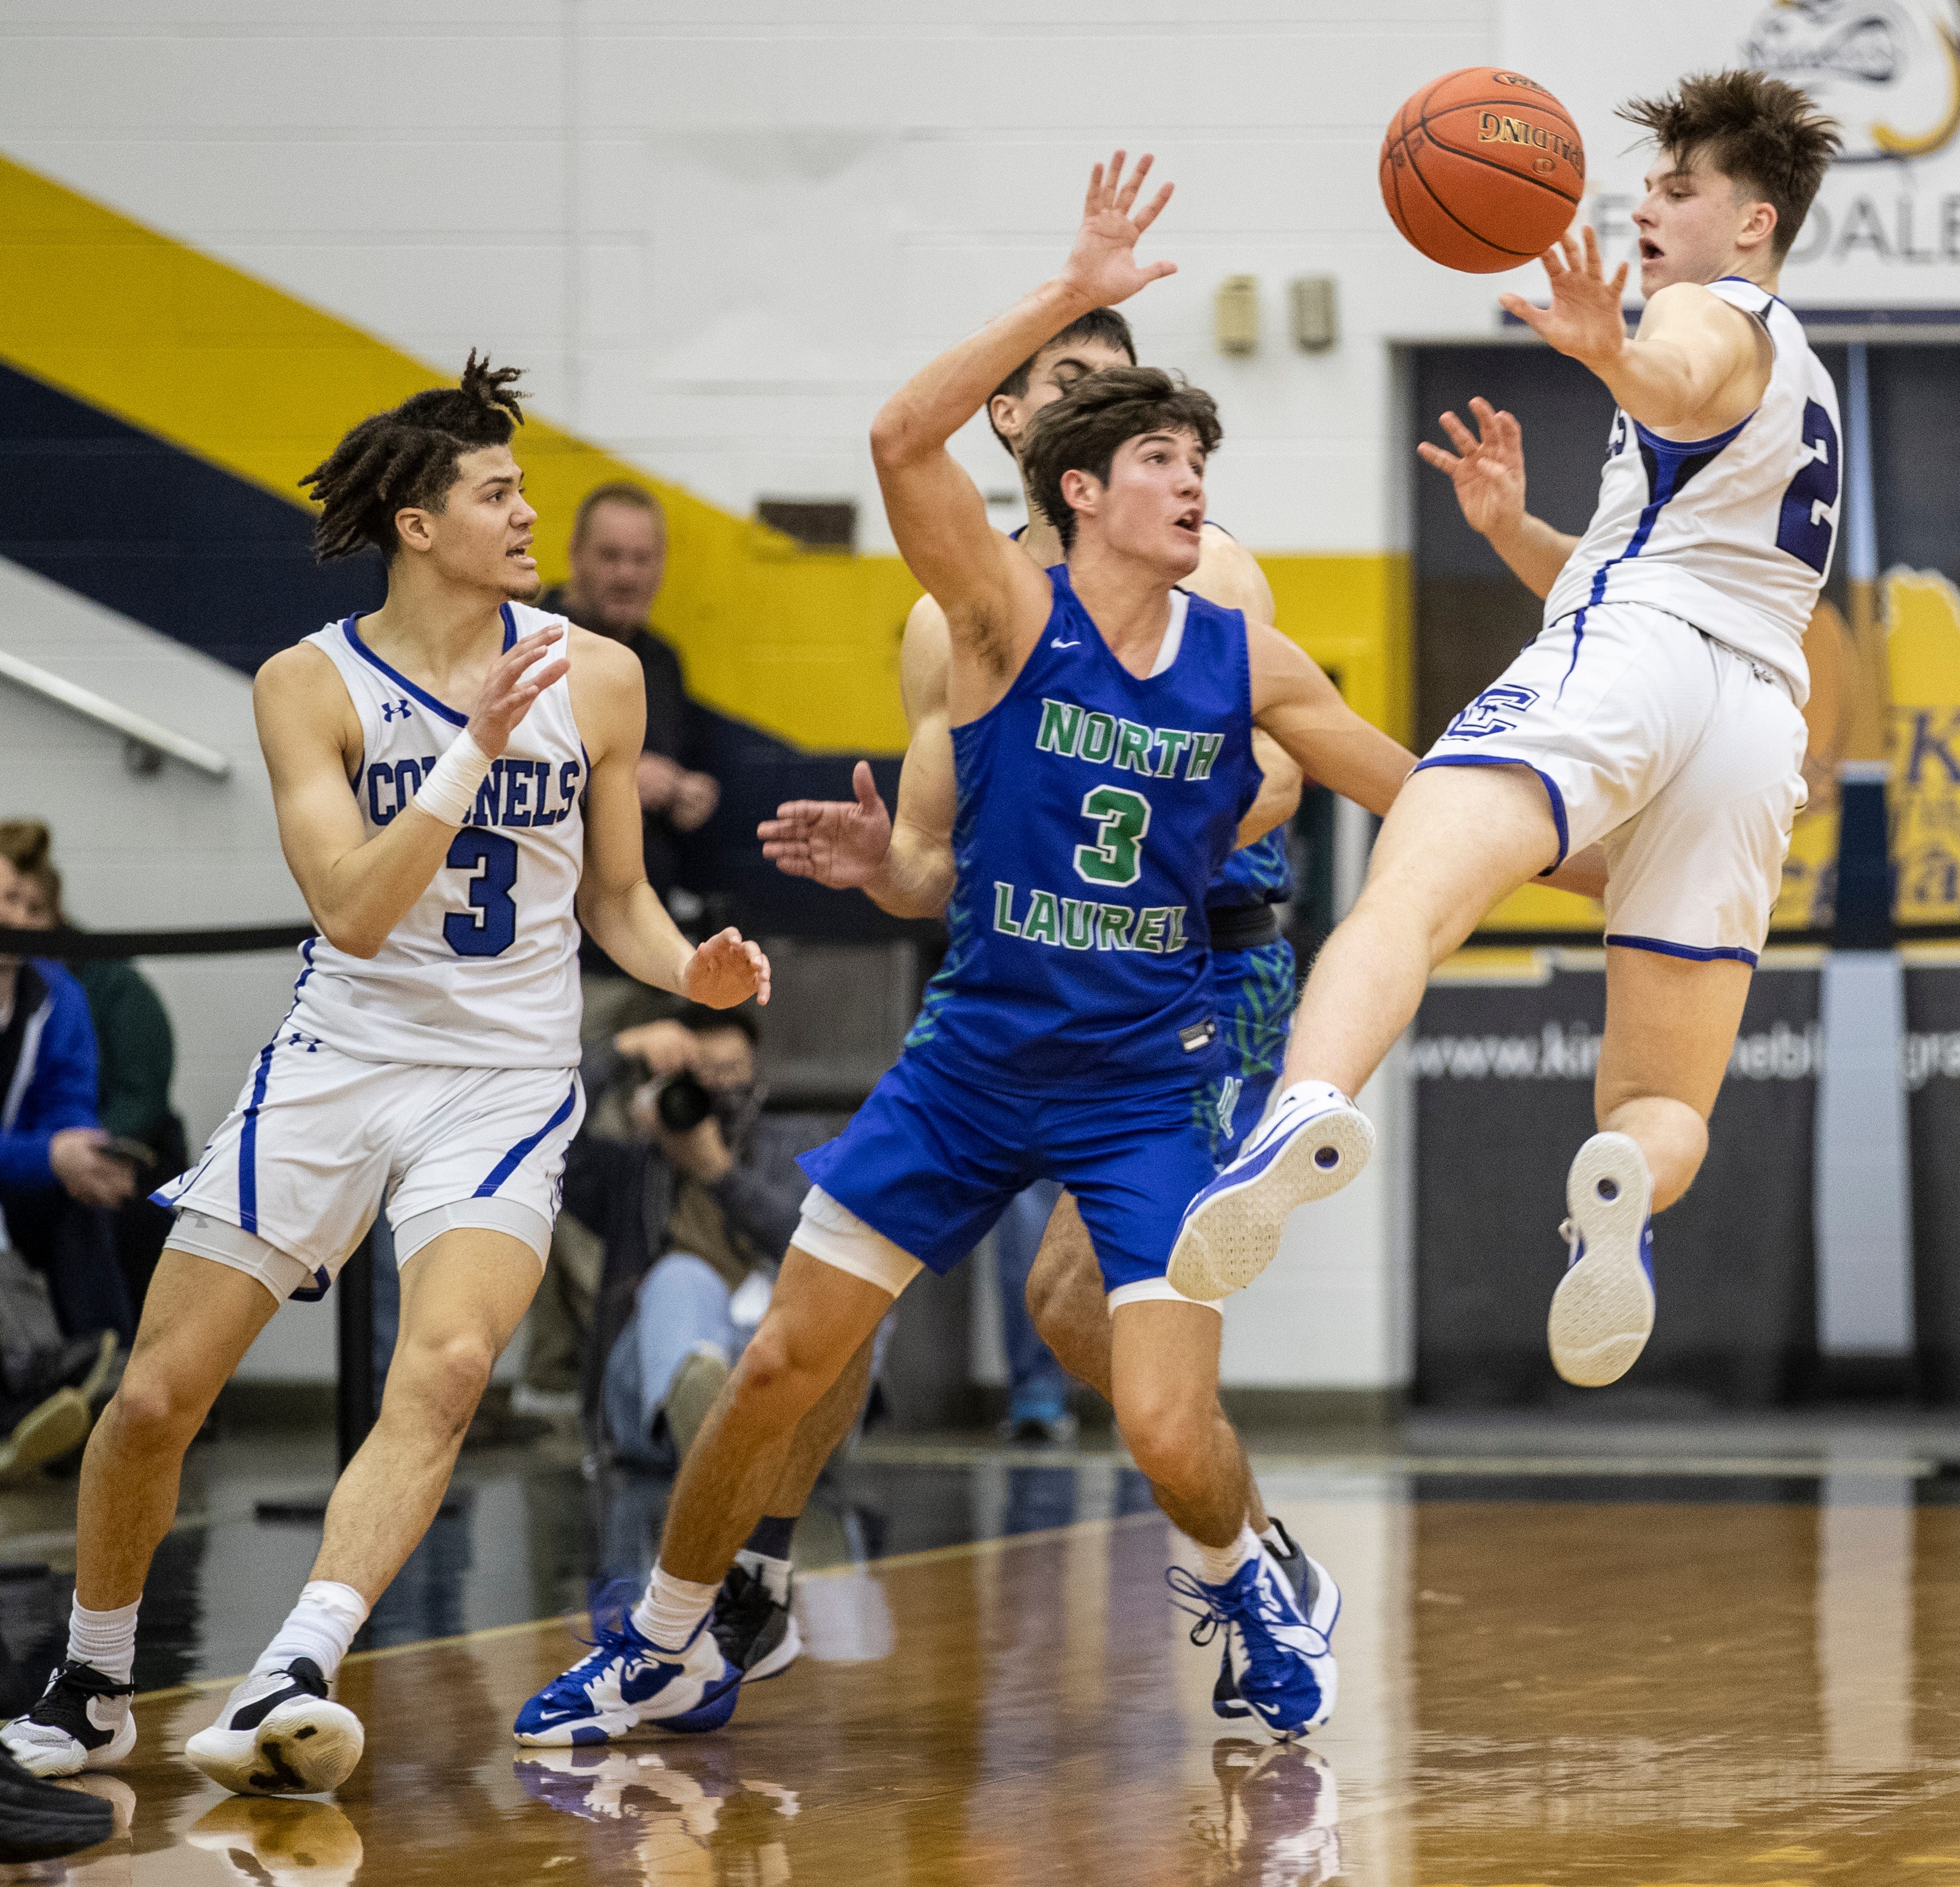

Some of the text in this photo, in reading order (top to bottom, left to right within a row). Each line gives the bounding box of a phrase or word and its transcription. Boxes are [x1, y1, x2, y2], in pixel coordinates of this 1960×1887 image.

[1776, 396, 1842, 577] 2
[1035, 698, 1225, 781] NORTH
[367, 756, 580, 827] CONELS
[1072, 784, 1152, 888] 3
[442, 825, 519, 957] 3
[993, 880, 1188, 954] LAUREL
